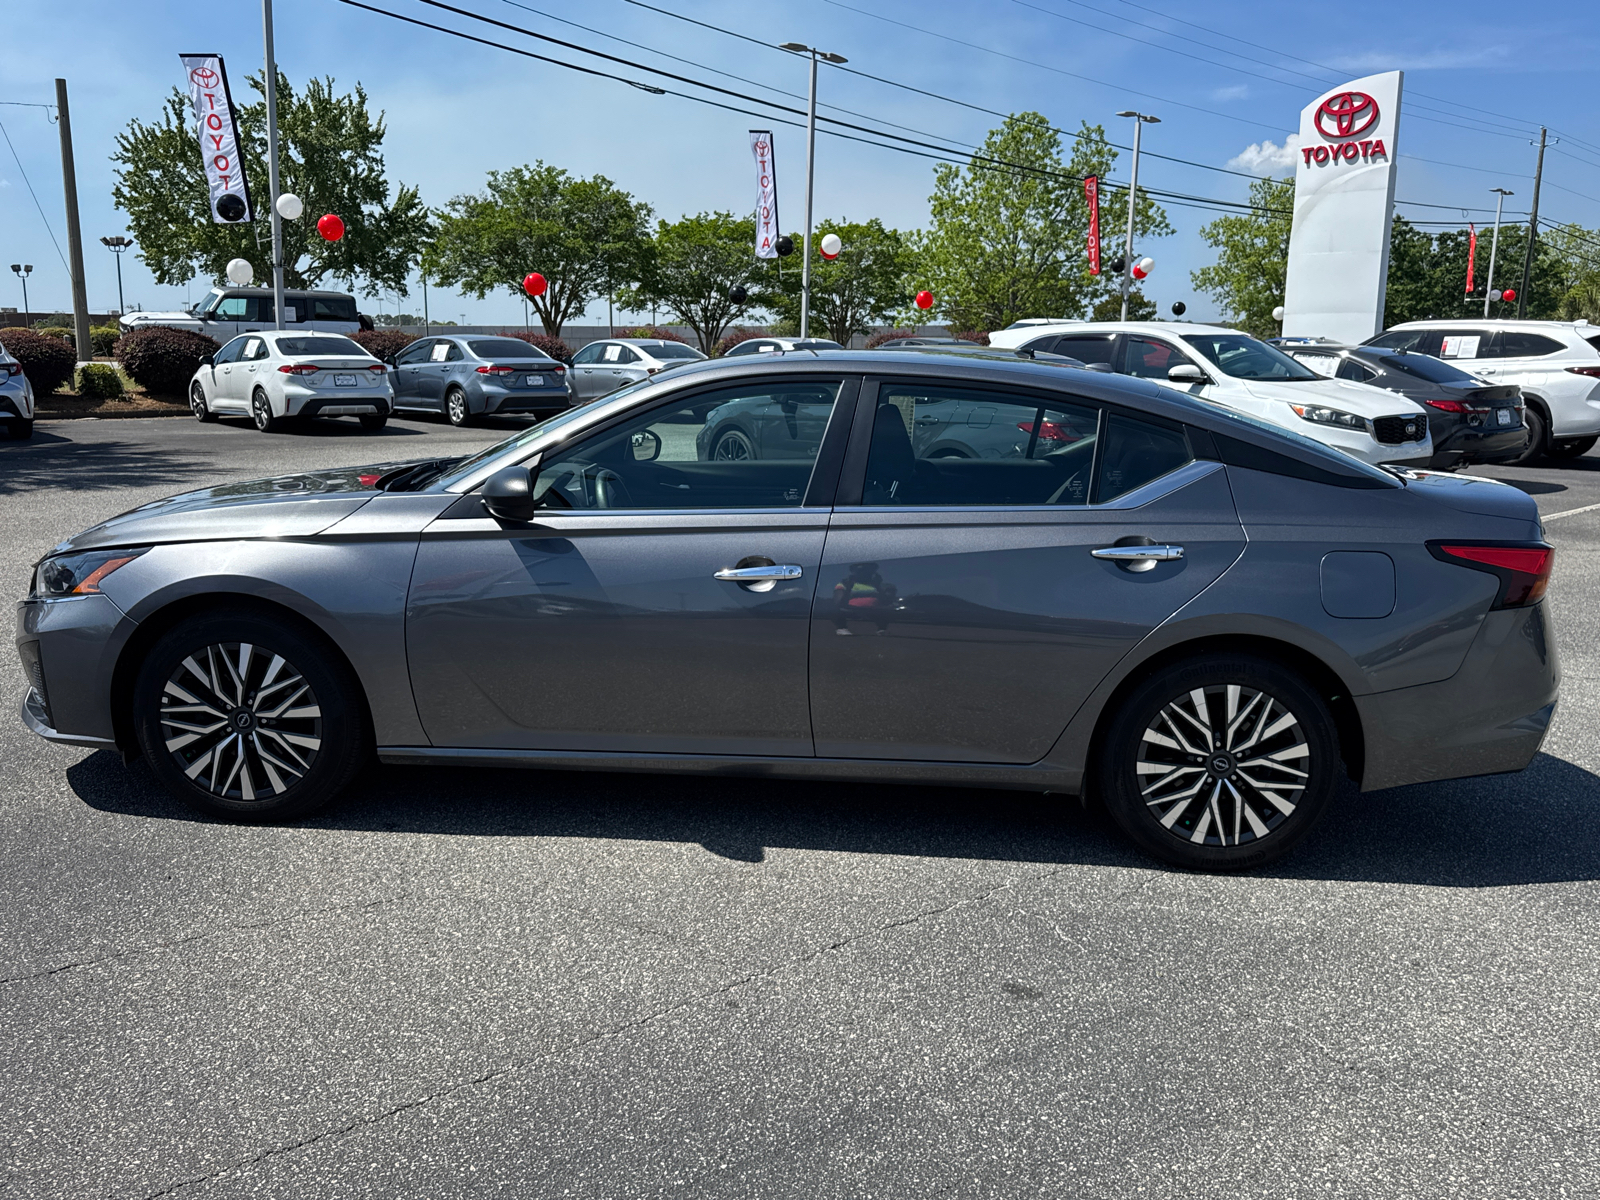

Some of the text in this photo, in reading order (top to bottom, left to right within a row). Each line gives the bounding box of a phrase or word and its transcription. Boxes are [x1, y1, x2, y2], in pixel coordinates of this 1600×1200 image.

[204, 93, 231, 190] TOYOT
[1301, 139, 1386, 163] TOYOTA
[759, 160, 771, 248] TOYOTA
[1179, 663, 1247, 681] Continental
